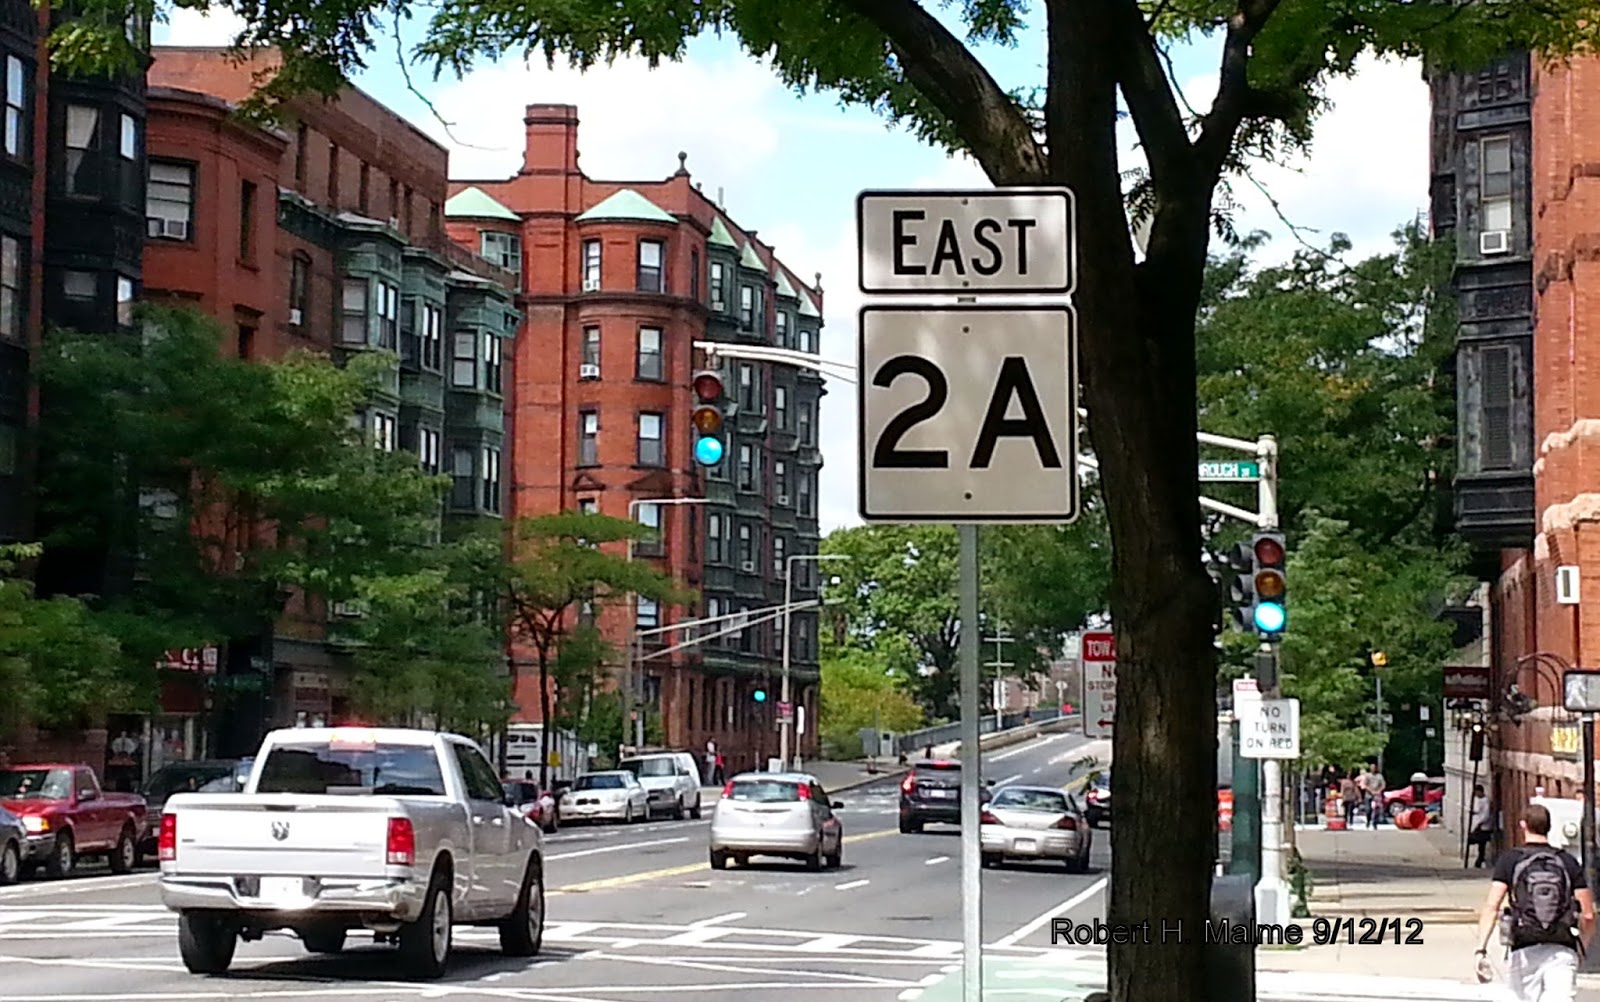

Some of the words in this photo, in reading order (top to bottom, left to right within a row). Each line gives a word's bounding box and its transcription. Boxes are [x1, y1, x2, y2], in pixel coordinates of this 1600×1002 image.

[893, 210, 1036, 276] EAST
[872, 354, 1062, 470] 2A
[1199, 462, 1238, 477] ROUGH
[1087, 640, 1111, 657] TOW
[1102, 664, 1112, 678] N
[1088, 681, 1114, 690] STOP
[1261, 706, 1280, 718] NO
[1255, 722, 1287, 734] TURN
[1247, 738, 1263, 749] ON
[1270, 738, 1293, 749] RED
